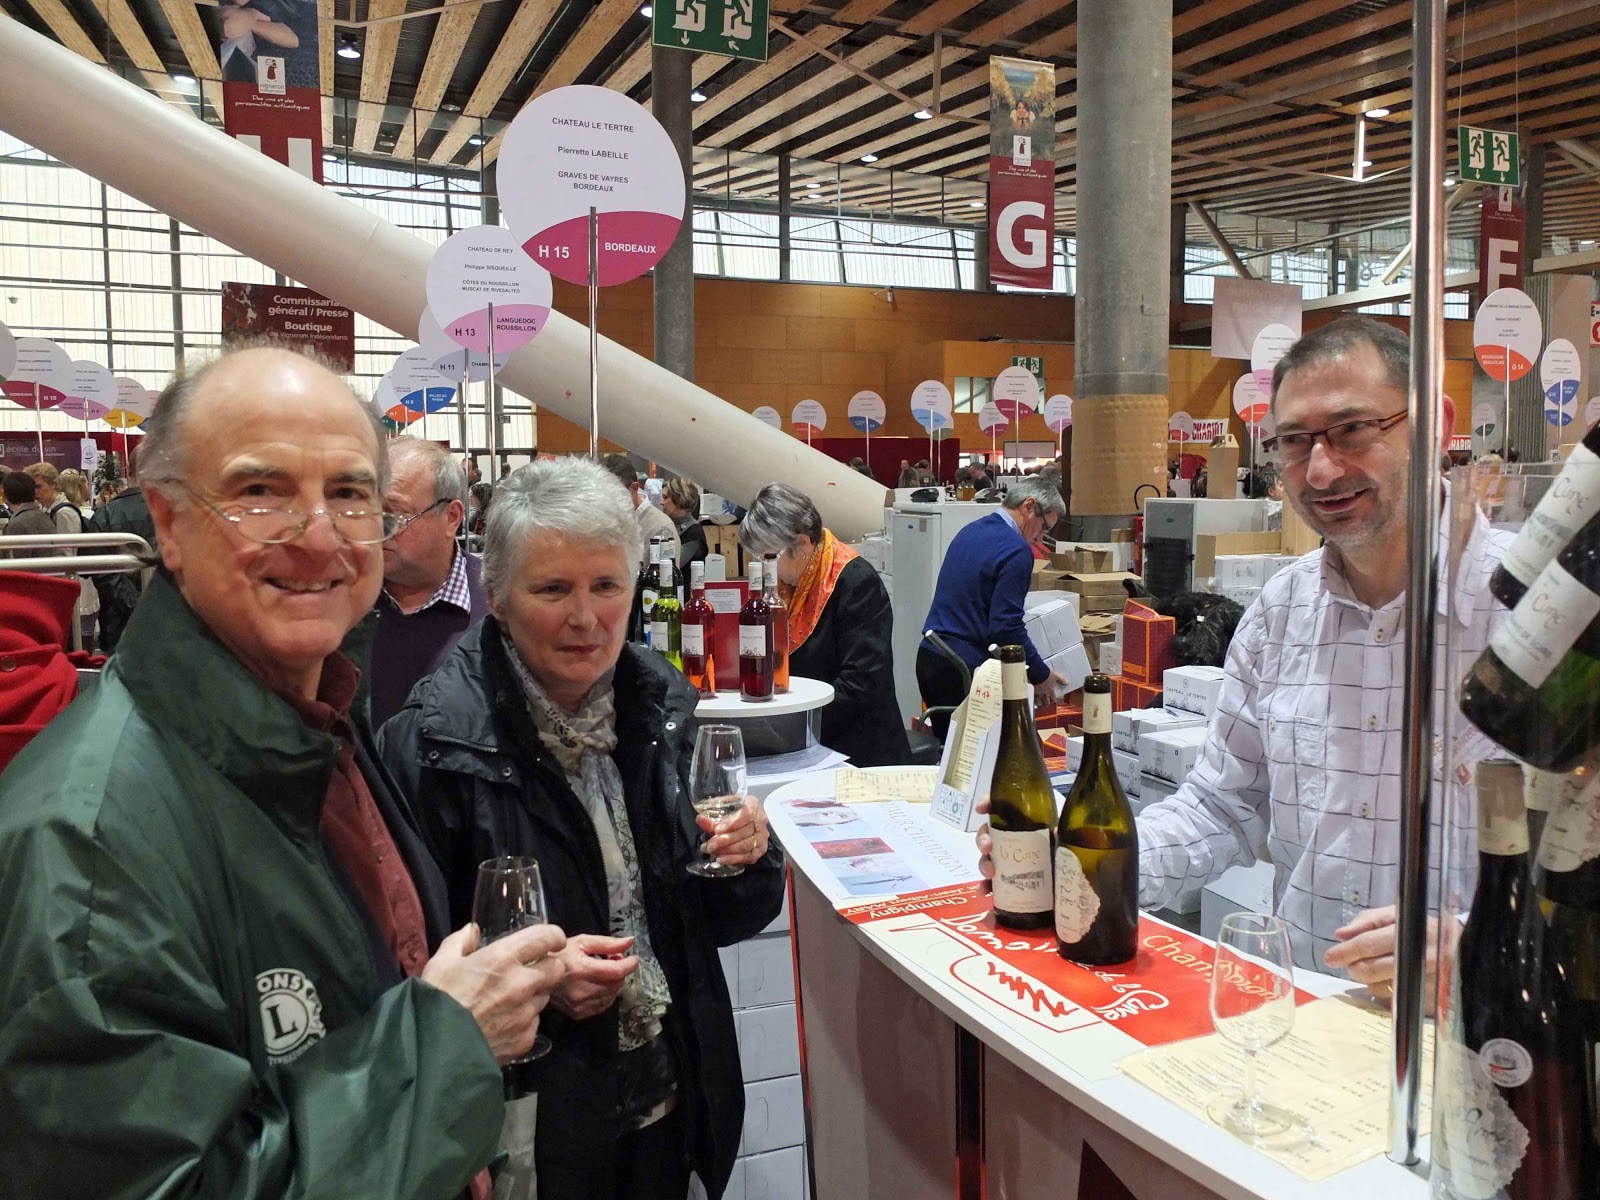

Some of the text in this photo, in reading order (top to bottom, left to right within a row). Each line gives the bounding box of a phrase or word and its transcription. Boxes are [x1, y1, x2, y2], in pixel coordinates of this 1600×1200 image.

[552, 117, 635, 133] CHATEAU LE TERTRE
[557, 146, 629, 160] Pierrette LABEILLE
[558, 170, 629, 184] GRAVES DE VAYRES
[573, 182, 614, 192] BORDEAUX
[995, 200, 1048, 269] G
[539, 245, 570, 259] H 15
[604, 242, 657, 254] BORDEAUX
[273, 294, 342, 307] Commissaria
[268, 306, 308, 317] général
[316, 308, 349, 318] Presse
[284, 321, 333, 333] Boutique
[455, 328, 476, 337] H 13
[891, 887, 965, 905] Jean-Albert
[847, 903, 887, 914] MARY
[869, 896, 968, 919] Champigny
[256, 973, 302, 993] ONS
[265, 1003, 299, 1040] L
